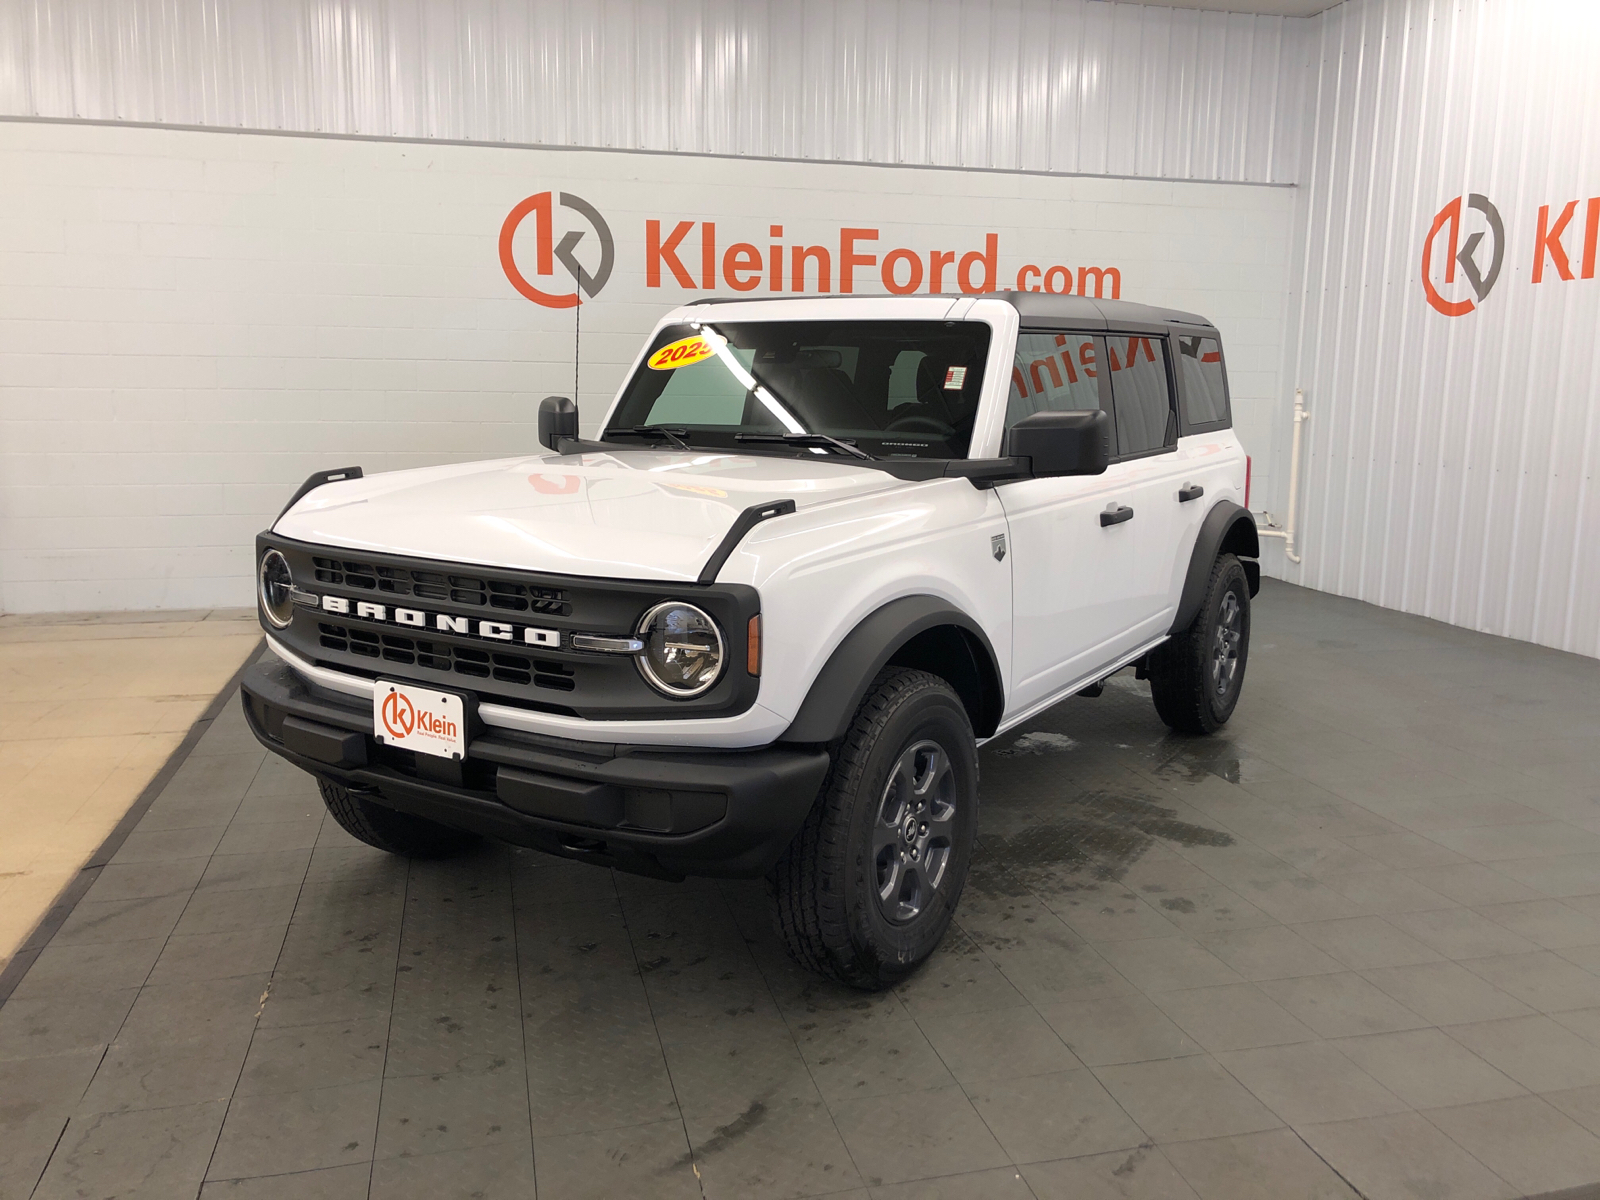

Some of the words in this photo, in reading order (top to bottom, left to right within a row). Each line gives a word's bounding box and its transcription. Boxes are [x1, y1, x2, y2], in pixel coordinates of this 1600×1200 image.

[646, 219, 1121, 300] KleinFordcom
[654, 342, 713, 366] 2025
[322, 595, 561, 648] BRONCO
[417, 709, 457, 738] Klein
